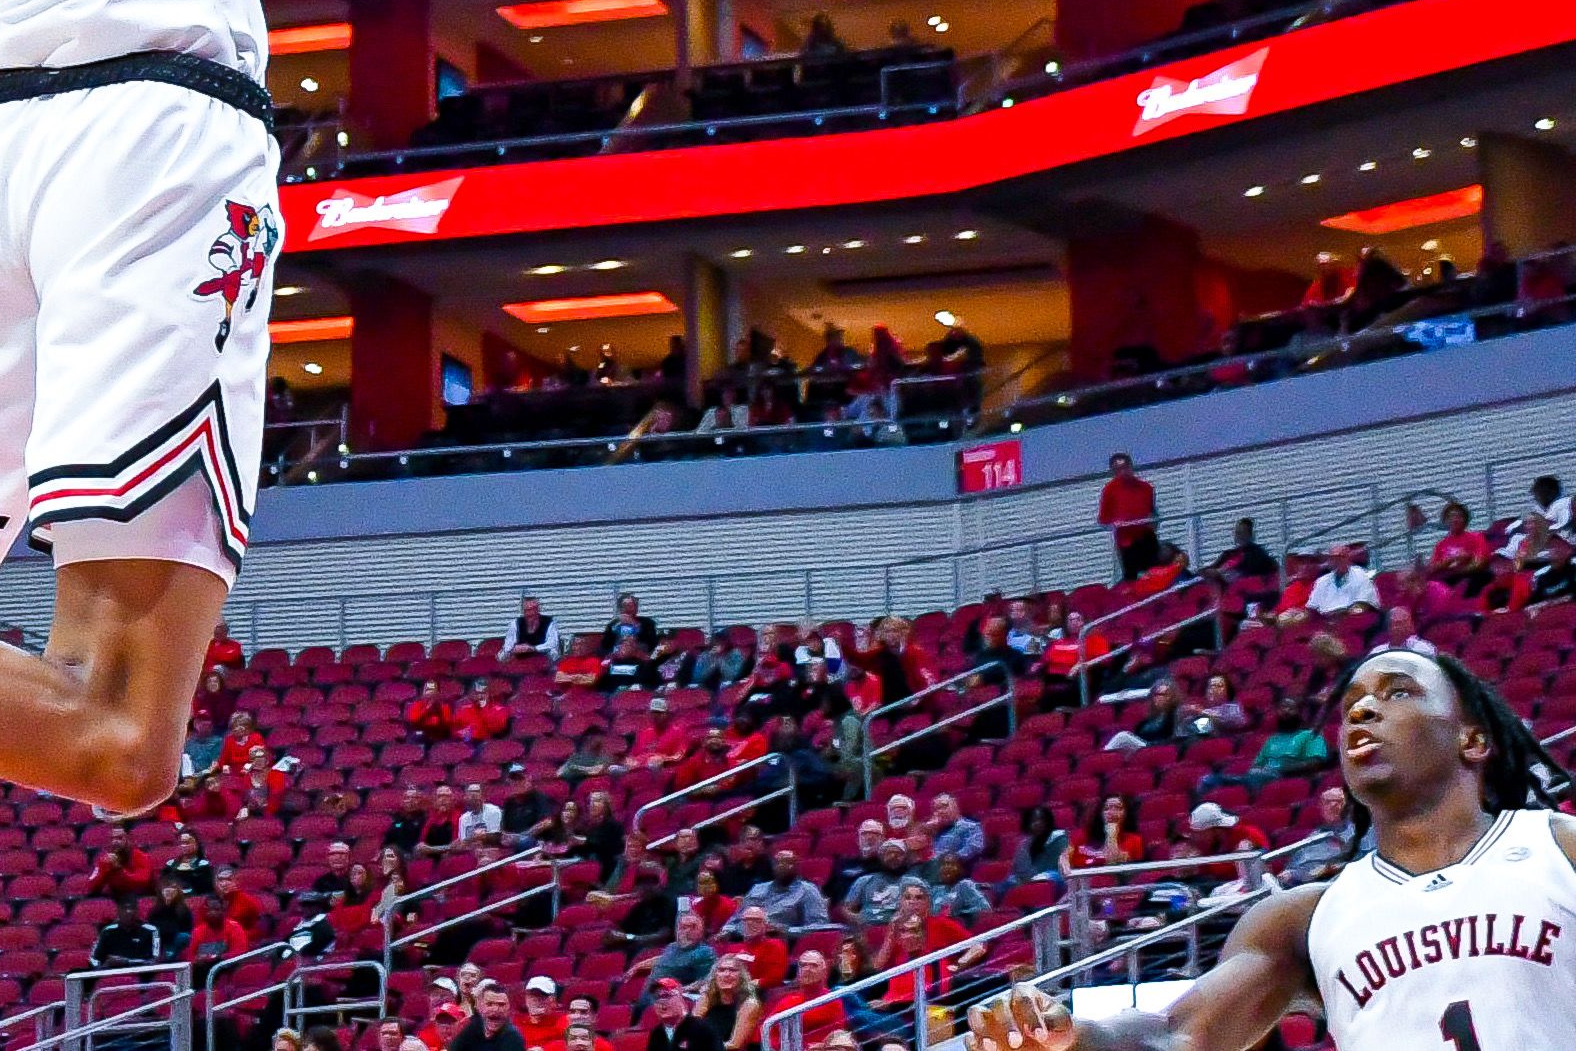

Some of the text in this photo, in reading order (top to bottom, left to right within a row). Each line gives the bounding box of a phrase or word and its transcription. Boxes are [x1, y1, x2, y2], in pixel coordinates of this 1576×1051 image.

[981, 459, 1016, 489] 114
[1337, 914, 1562, 1009] LOUISVILLE
[1438, 1000, 1482, 1051] 1
